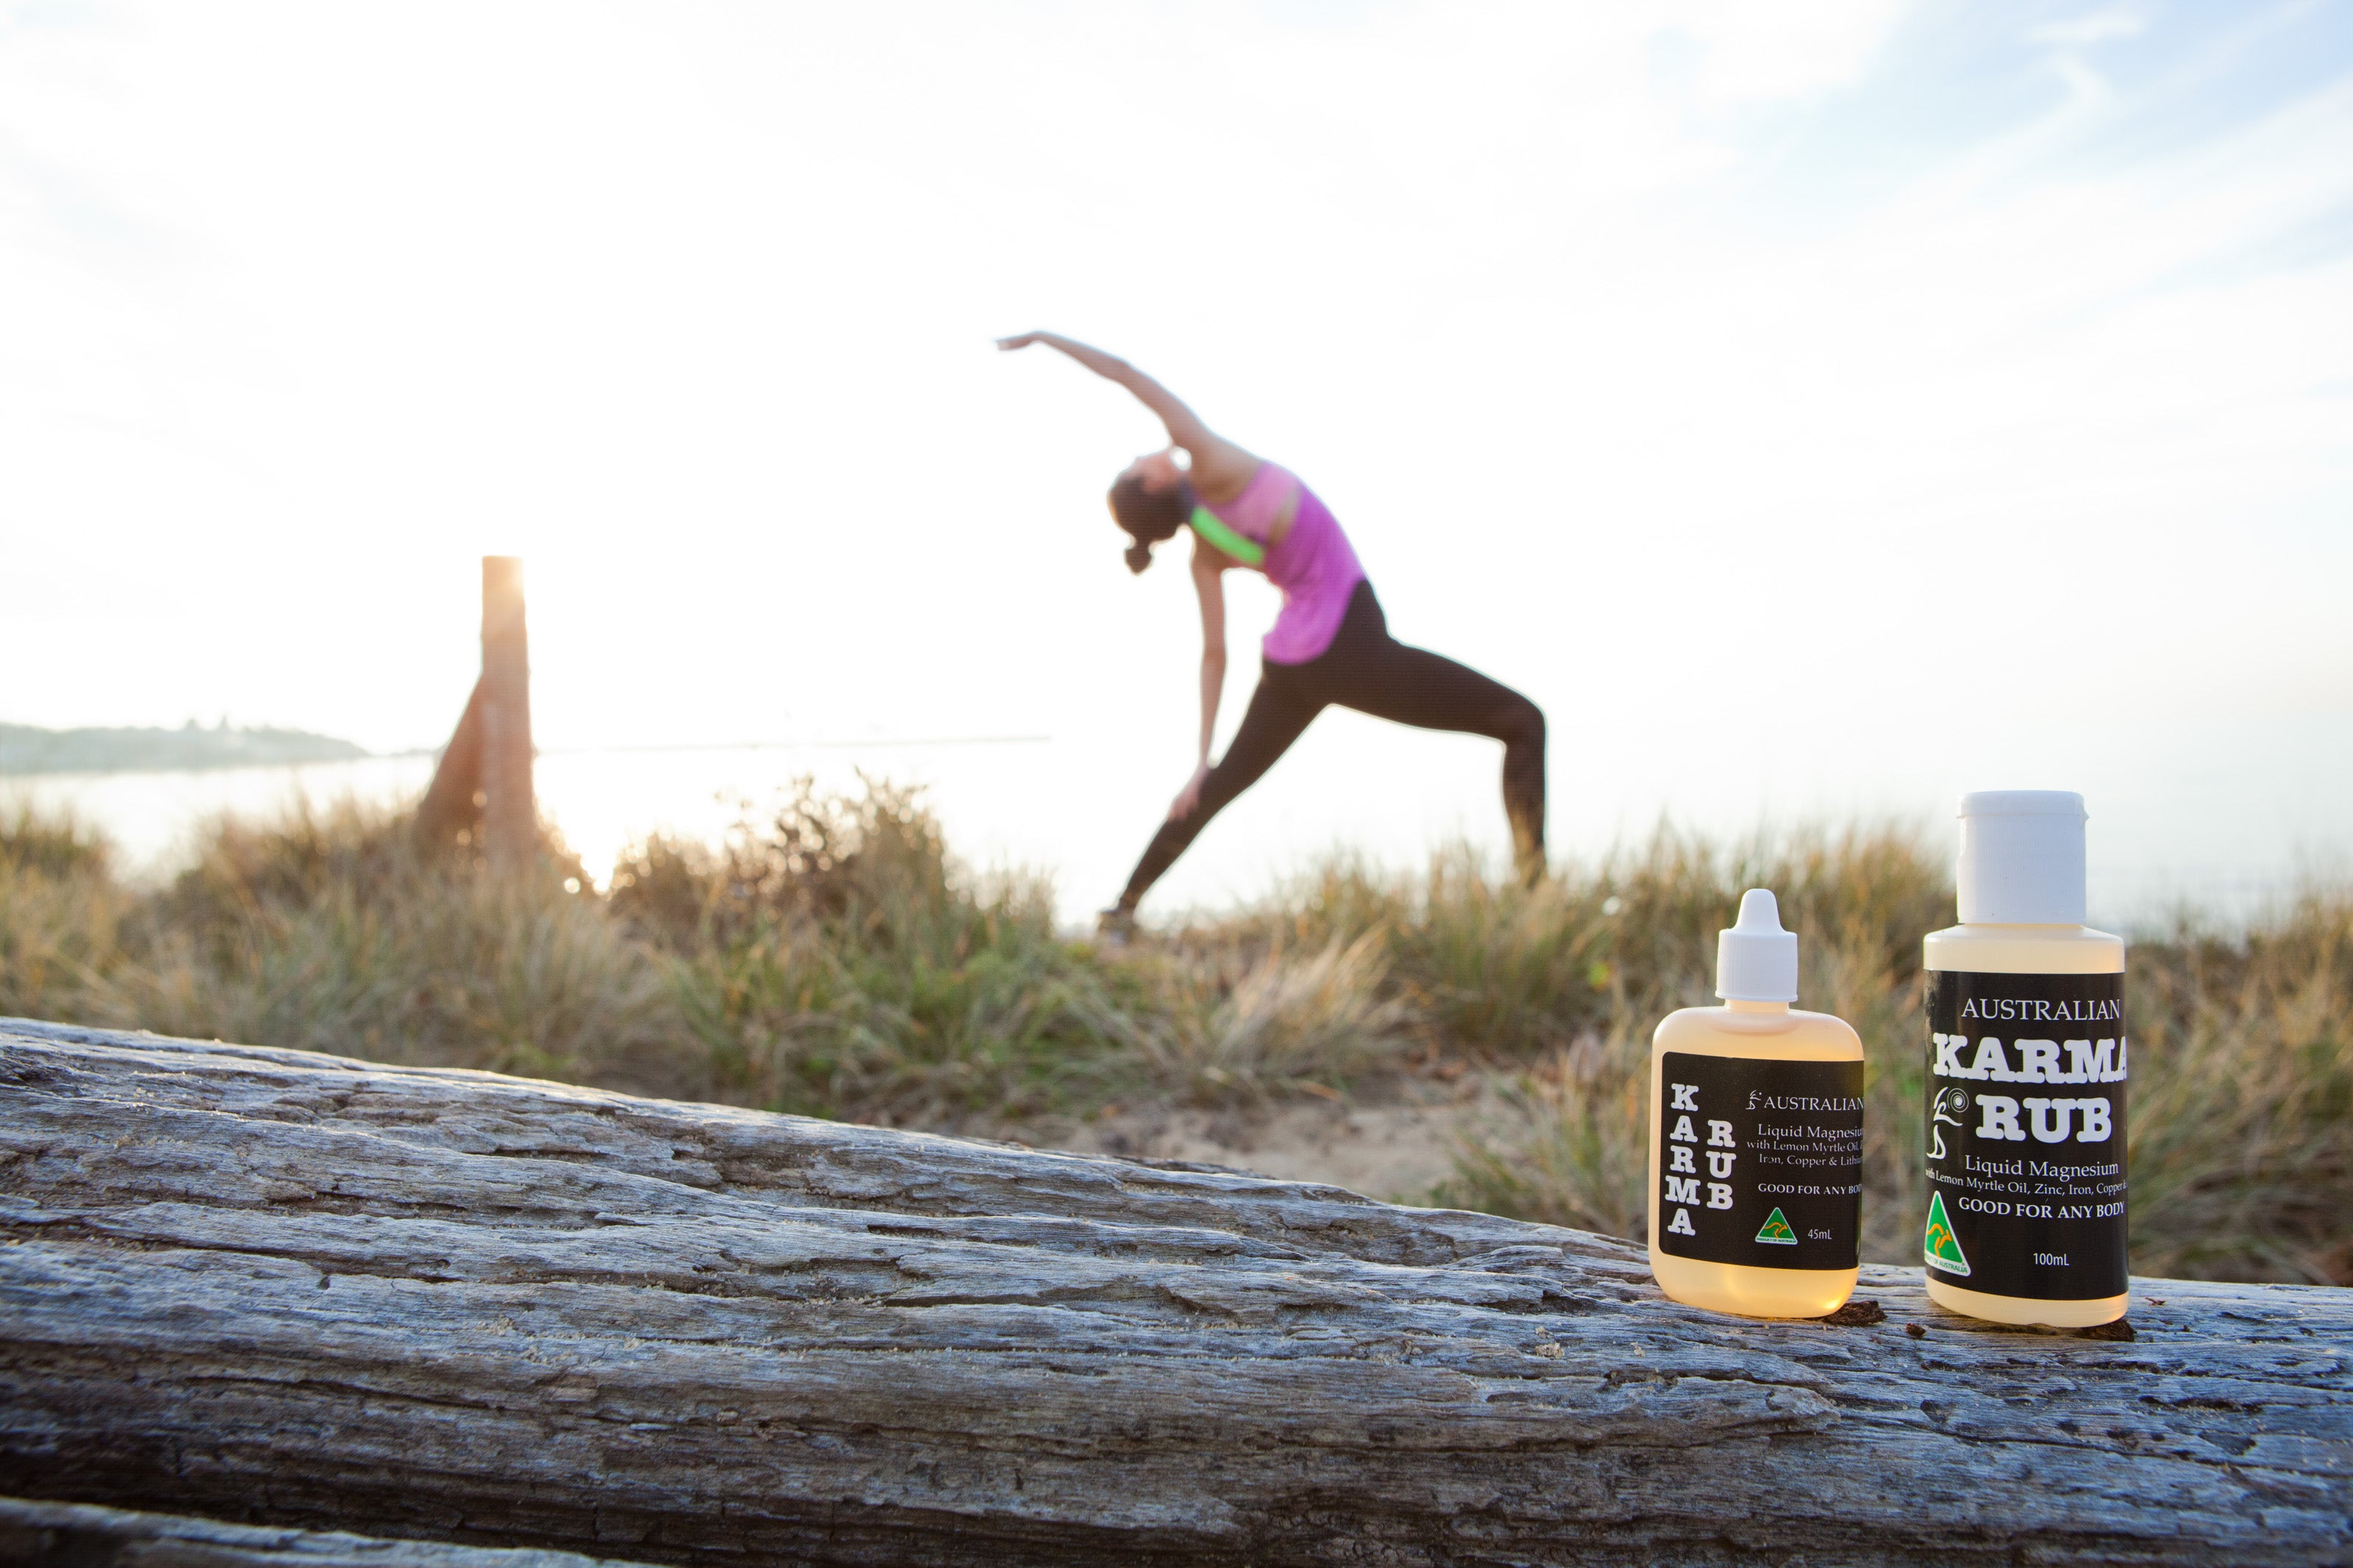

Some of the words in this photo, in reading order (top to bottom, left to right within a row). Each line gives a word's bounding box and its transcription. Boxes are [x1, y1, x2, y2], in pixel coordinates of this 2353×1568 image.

[1961, 998, 2121, 1020] AUSTRALIAN
[1932, 1032, 2127, 1084] KARMA
[1764, 1096, 1863, 1111] AUSTRALIAN
[1975, 1094, 2112, 1143] RUB
[1758, 1124, 1802, 1140] Liquid
[1747, 1139, 1770, 1150] with
[1774, 1141, 1809, 1151] Lemon
[1813, 1142, 1846, 1155] Myrtle
[1665, 1083, 1701, 1236] KARMA
[1705, 1120, 1737, 1210] RUB
[1760, 1153, 1784, 1164] Iron,
[1787, 1155, 1827, 1168] Copper
[1829, 1156, 1838, 1166] &
[1840, 1155, 1863, 1166] Lithiu
[1965, 1155, 2023, 1177] Liquid
[2029, 1161, 2119, 1181] Magnesium
[1758, 1183, 1795, 1194] GOOD
[1798, 1185, 1821, 1195] FOR
[1824, 1186, 1846, 1195] ANY
[1849, 1183, 1863, 1194] BOD
[1935, 1170, 1964, 1186] Lemon
[1966, 1178, 2004, 1192] Myrtle
[2007, 1181, 2030, 1195] Oil,
[2035, 1183, 2065, 1196] Zinc,
[2069, 1185, 2094, 1195] Iron,
[2096, 1183, 2123, 1196] Copper
[1958, 1197, 2011, 1215] GOOD
[2015, 1203, 2053, 1219] FOR
[2057, 1205, 2093, 1219] ANY
[2096, 1200, 2124, 1217] BODY
[1808, 1229, 1832, 1239] 45mL
[2033, 1253, 2070, 1267] 100mL
